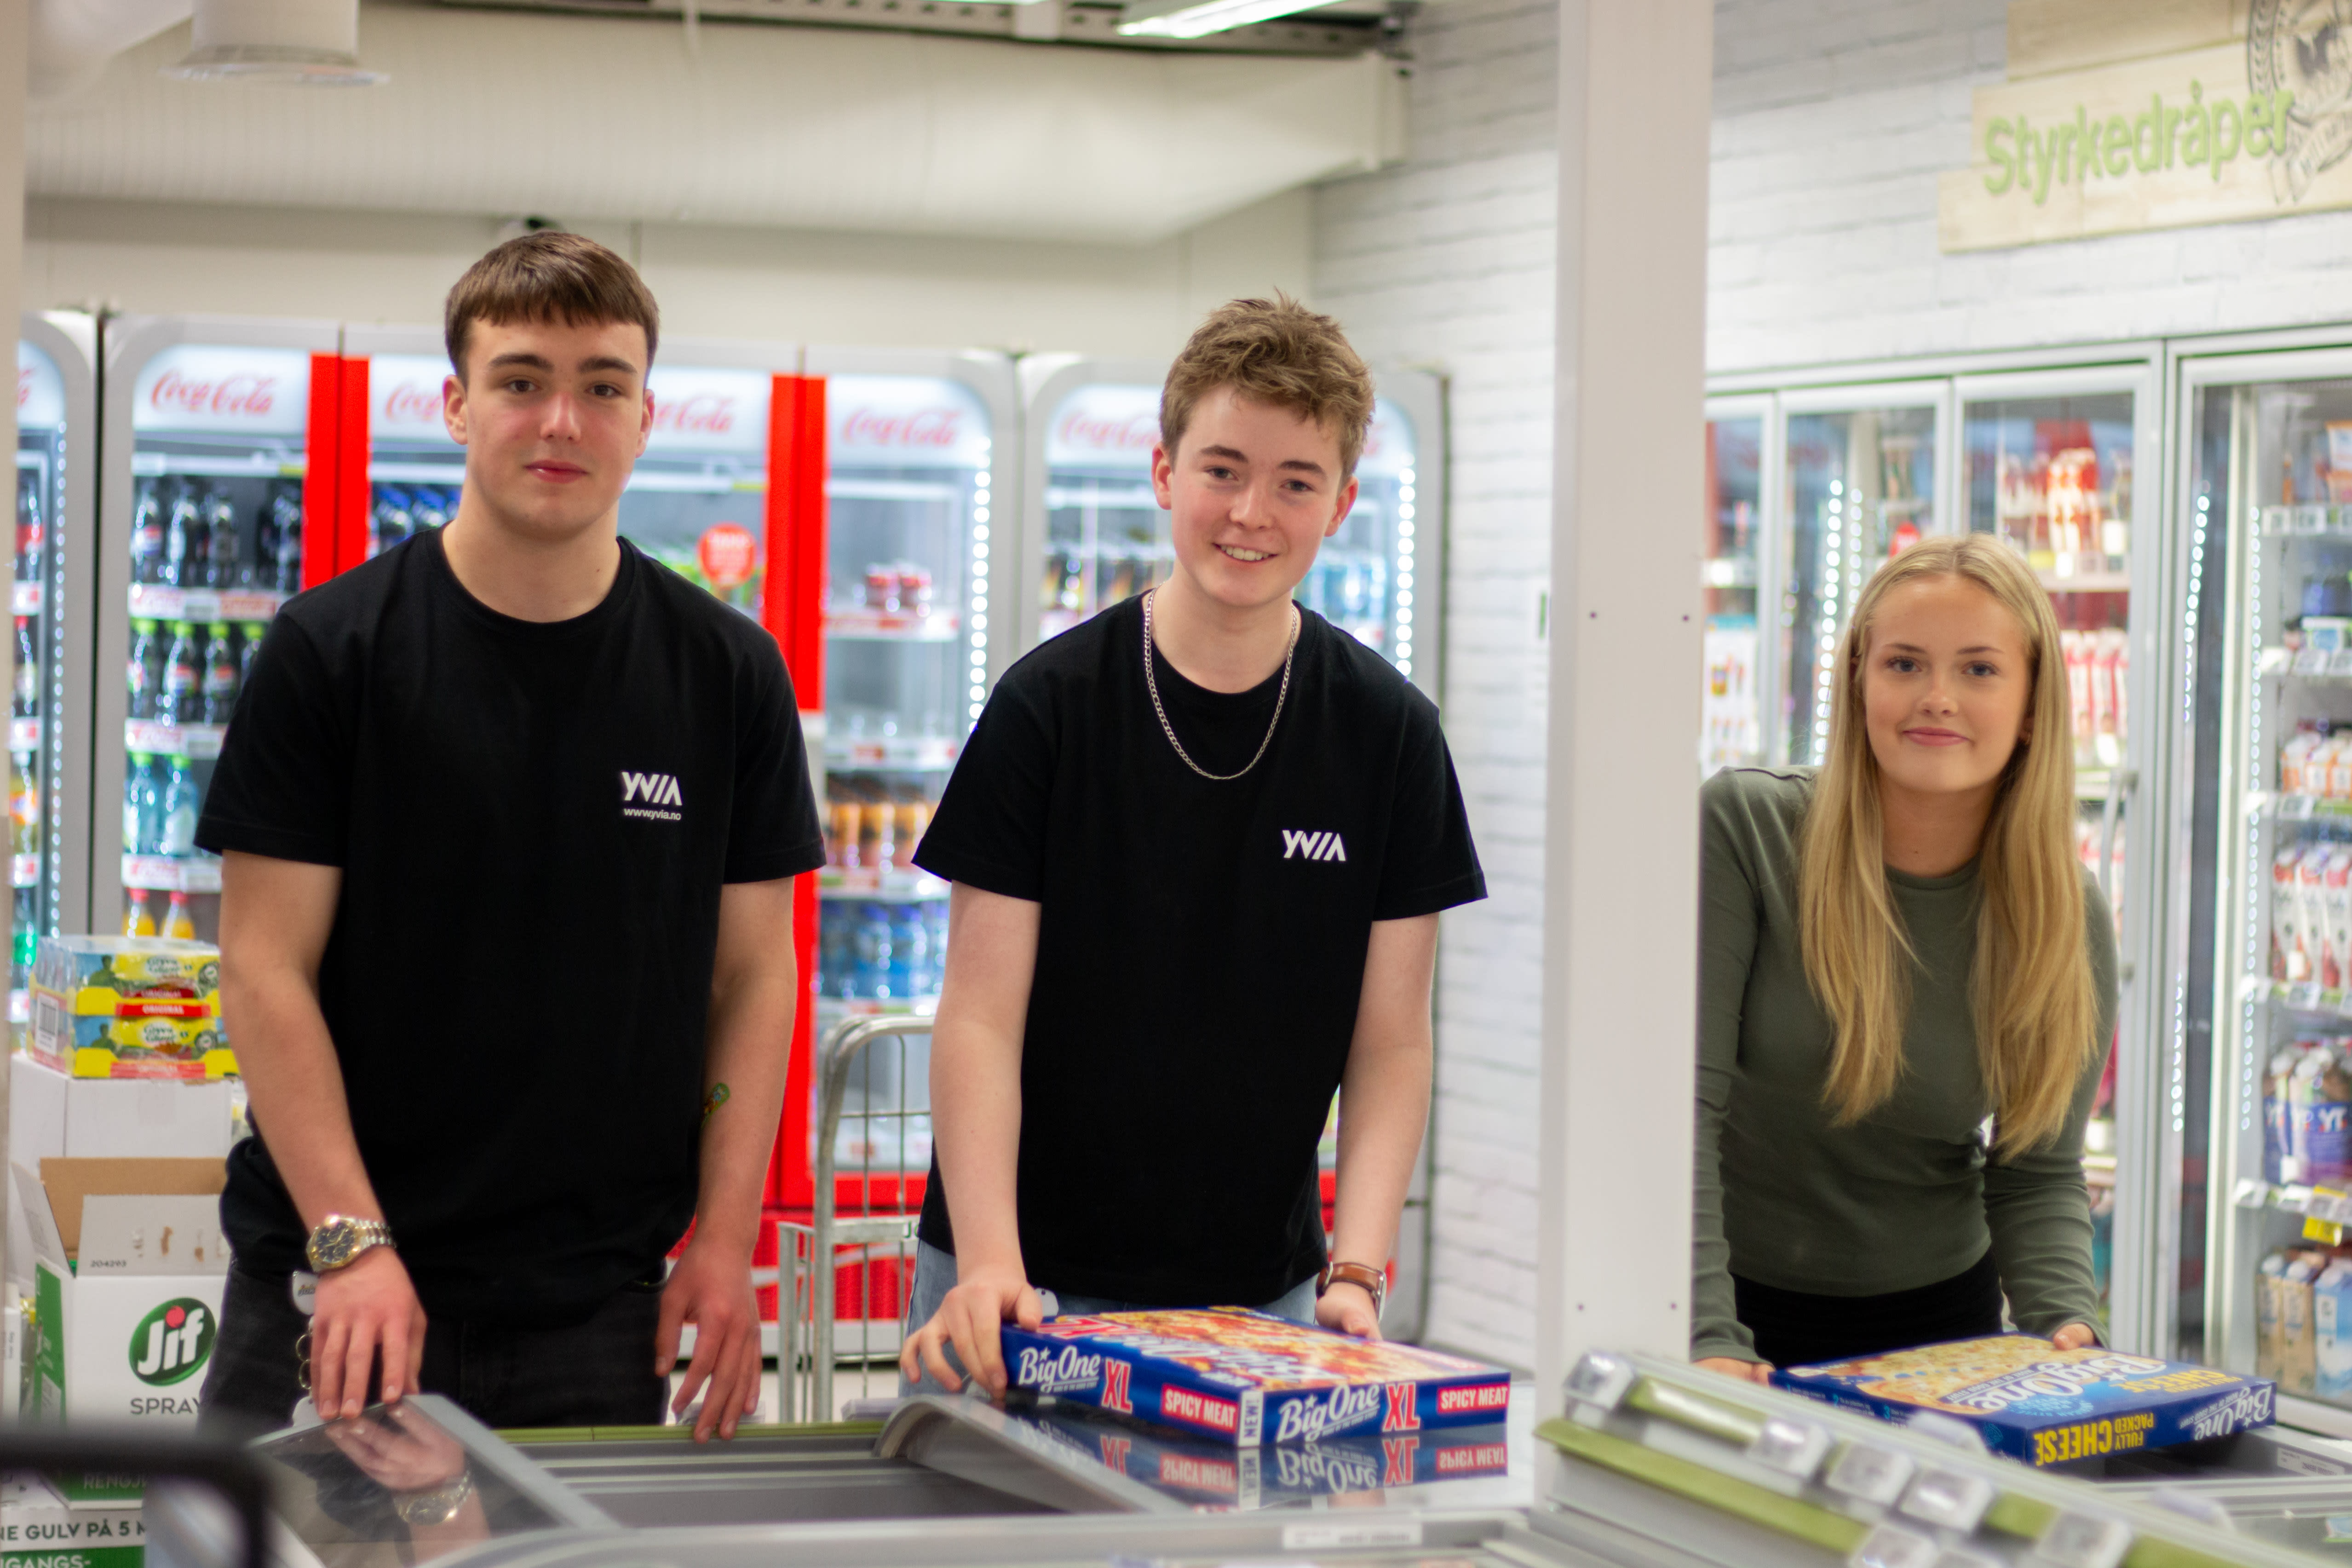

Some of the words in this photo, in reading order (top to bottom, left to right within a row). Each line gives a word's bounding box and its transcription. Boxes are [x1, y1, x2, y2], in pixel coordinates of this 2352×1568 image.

[1984, 79, 2295, 206] Styrkedråper
[621, 772, 682, 806] YVIA
[624, 808, 682, 821] www.yvia.no
[1282, 830, 1346, 861] YVIA
[142, 1005, 184, 1015] ORIGINAL
[138, 1305, 205, 1376] Jif
[1101, 1356, 1133, 1415] XL
[1441, 1389, 1477, 1409] SPICY
[1478, 1386, 1508, 1406] MEAT
[1166, 1389, 1202, 1419] SPICY
[1203, 1399, 1236, 1428] MEAT
[1381, 1381, 1420, 1432] XL
[2115, 1413, 2154, 1434] PACKED
[2034, 1420, 2112, 1467] CHEESE
[2115, 1430, 2144, 1451] FULLY
[25, 1523, 81, 1540] GULV
[87, 1518, 113, 1537] PÅ
[119, 1521, 130, 1536] 5
[0, 1555, 91, 1568] GANGS-
